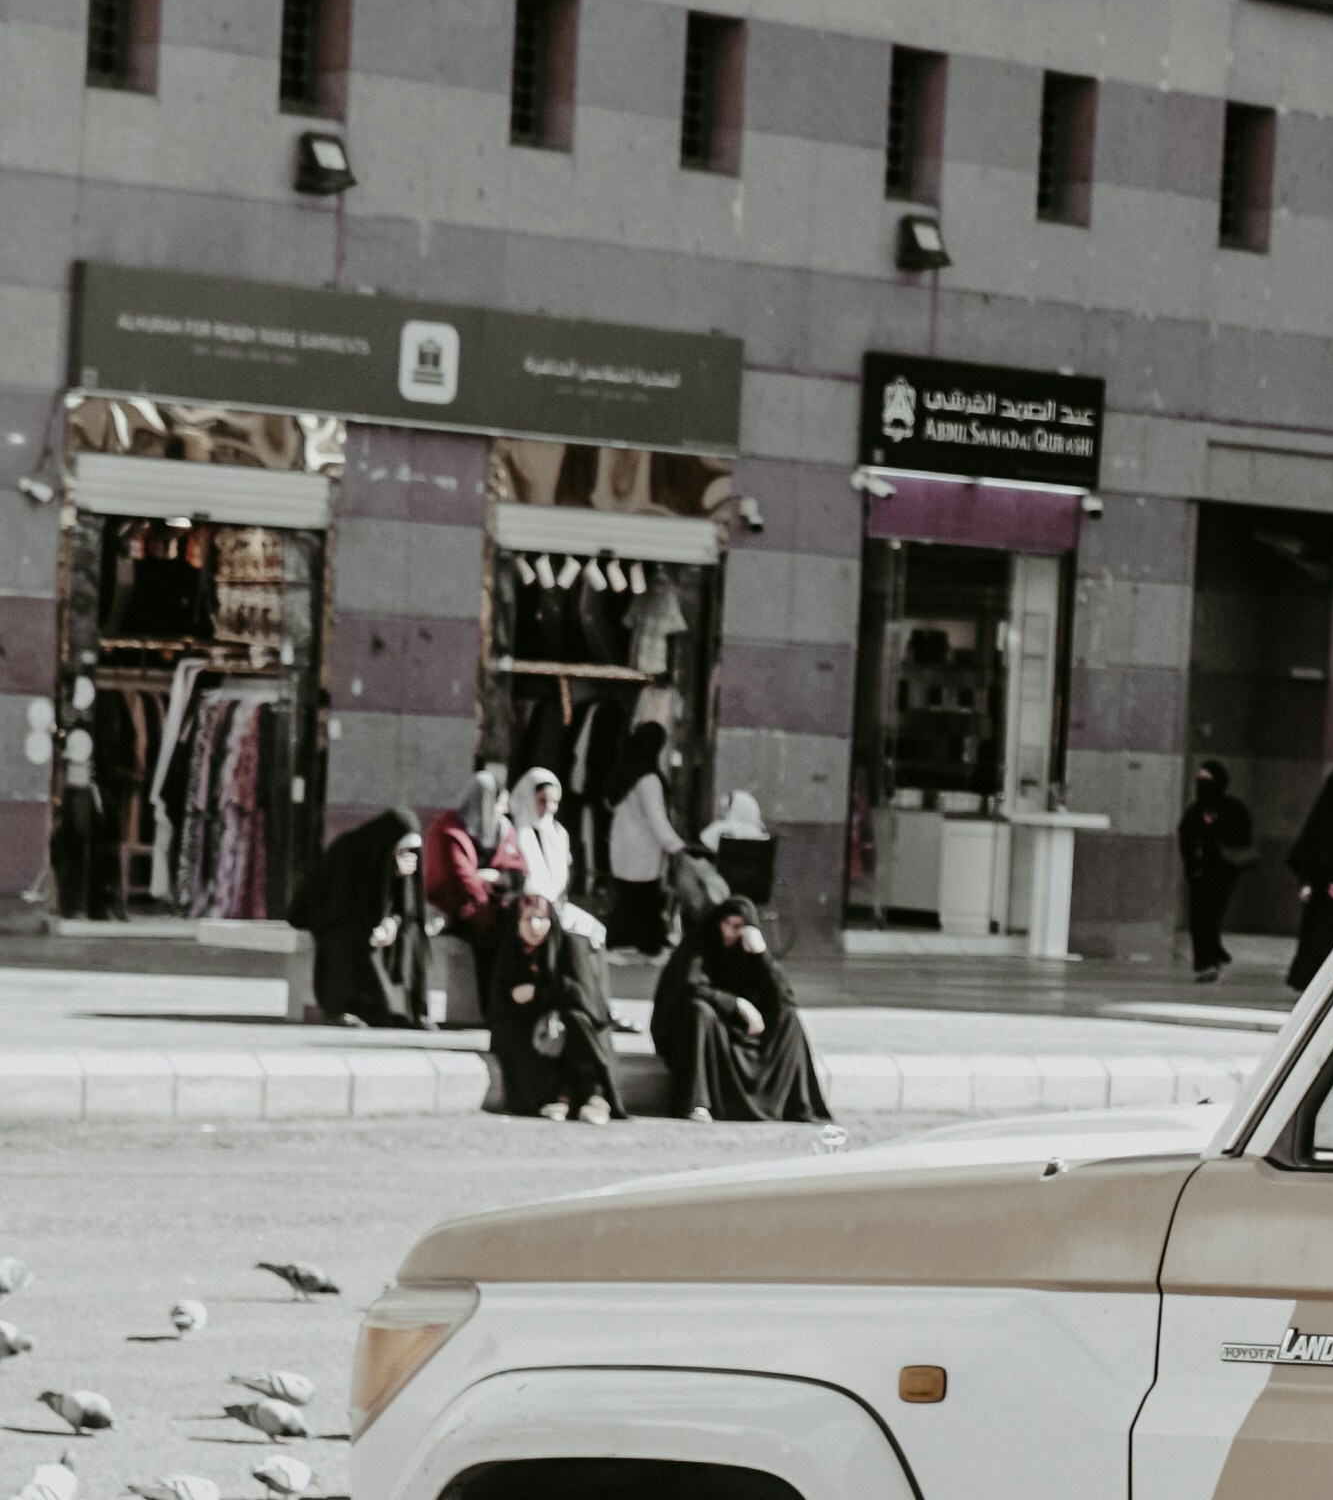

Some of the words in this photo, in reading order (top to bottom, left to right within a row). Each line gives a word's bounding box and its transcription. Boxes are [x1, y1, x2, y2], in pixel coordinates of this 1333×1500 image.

[1000, 398, 1057, 422] الصمد
[1059, 403, 1097, 427] عبد
[1224, 1346, 1276, 1360] TOYOTA
